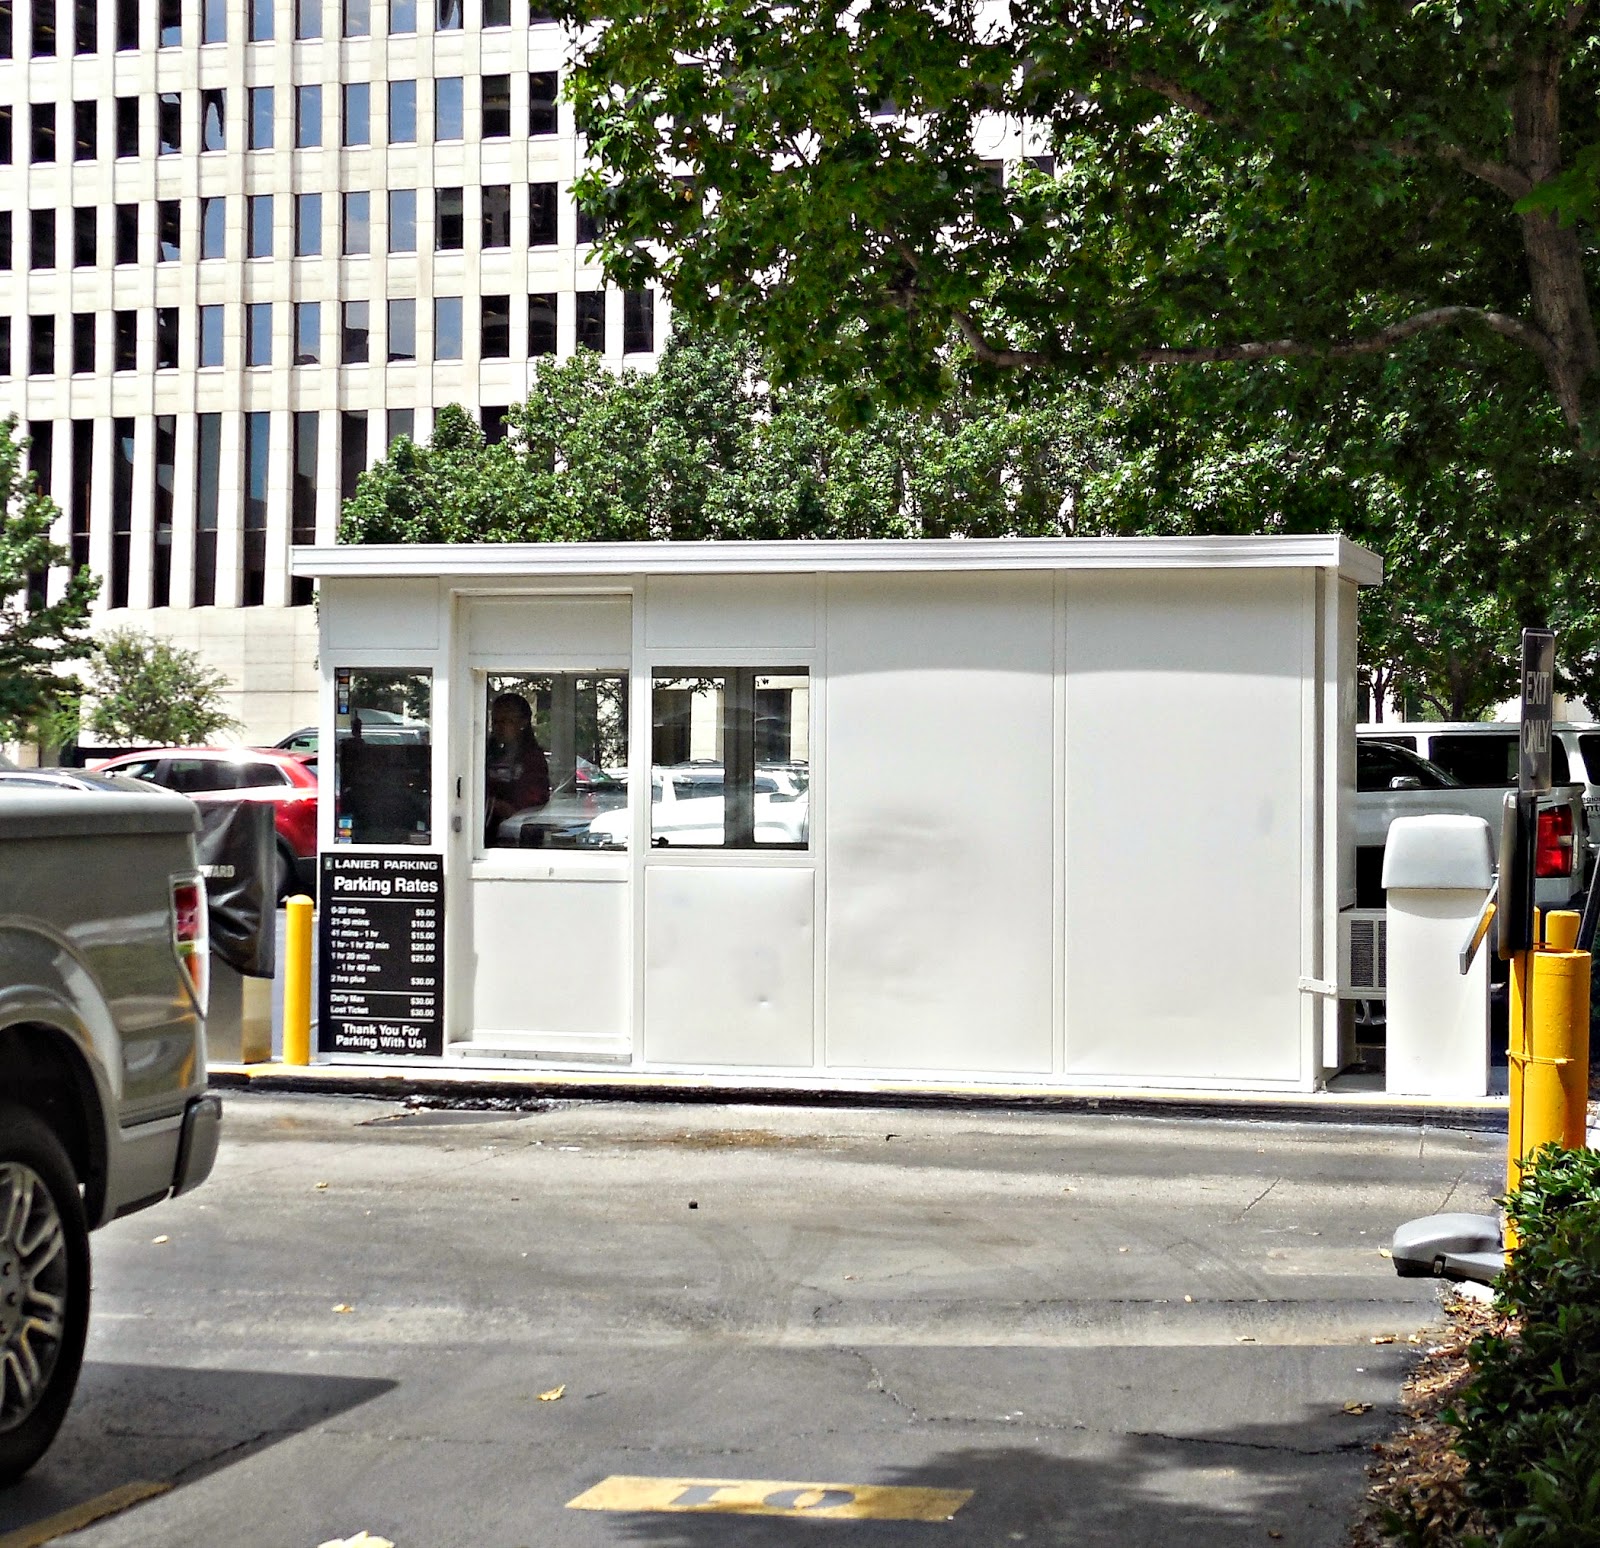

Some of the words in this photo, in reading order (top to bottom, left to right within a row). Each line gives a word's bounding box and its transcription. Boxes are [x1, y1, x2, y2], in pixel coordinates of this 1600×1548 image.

[1526, 671, 1549, 705] EXIT
[1523, 719, 1551, 754] ONLY
[335, 859, 379, 870] LANIER
[384, 860, 438, 870] PARKING
[334, 877, 391, 895] Parking
[395, 878, 438, 893] Rates
[415, 908, 436, 917] $5.00
[411, 920, 436, 928] $10.00
[411, 931, 436, 940] $15.00
[343, 1023, 376, 1035] Thank
[379, 1024, 399, 1037] You
[402, 1025, 421, 1037] For
[336, 1035, 378, 1049] Parking
[379, 1037, 405, 1048] With
[408, 1038, 427, 1049] Us!
